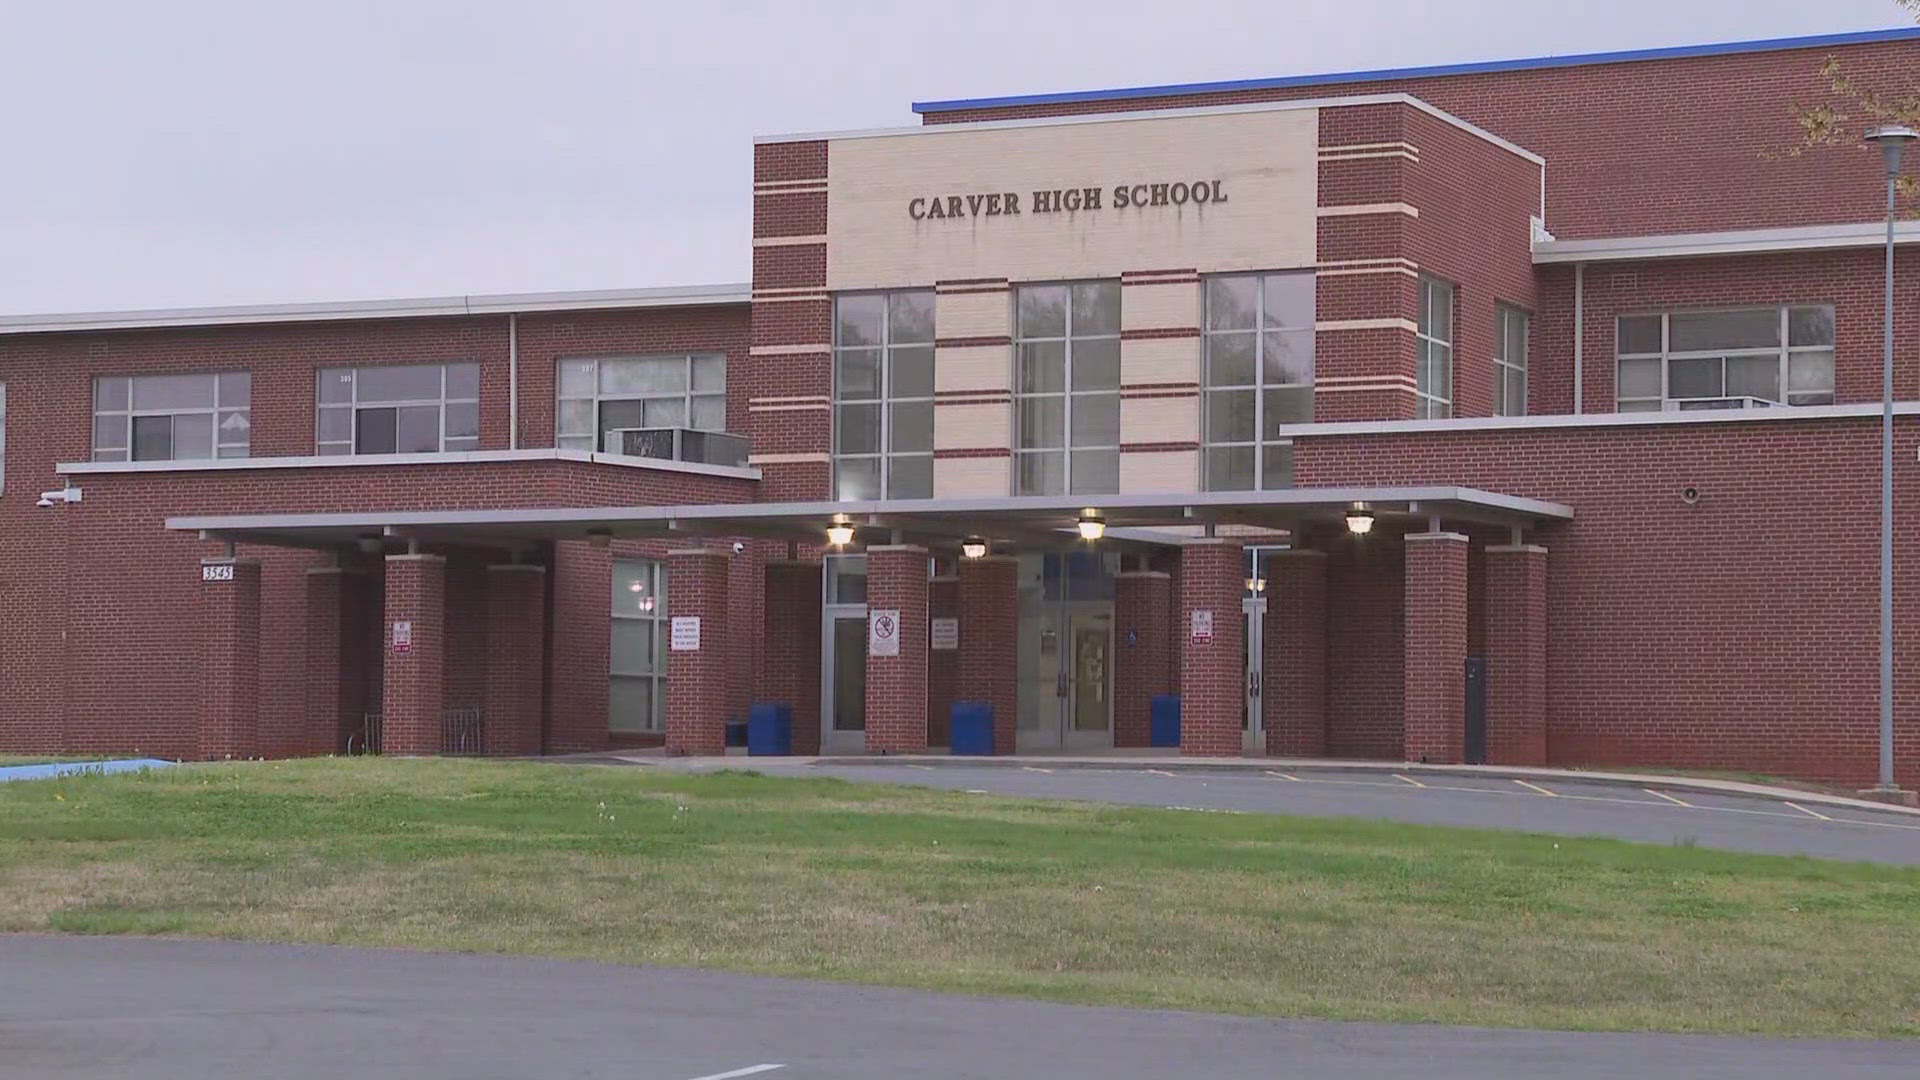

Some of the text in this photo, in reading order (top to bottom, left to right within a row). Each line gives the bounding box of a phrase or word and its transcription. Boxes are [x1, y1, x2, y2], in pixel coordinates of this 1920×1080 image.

[908, 180, 1228, 220] CARVER HIGH SCHOOL
[205, 567, 231, 580] 3545
